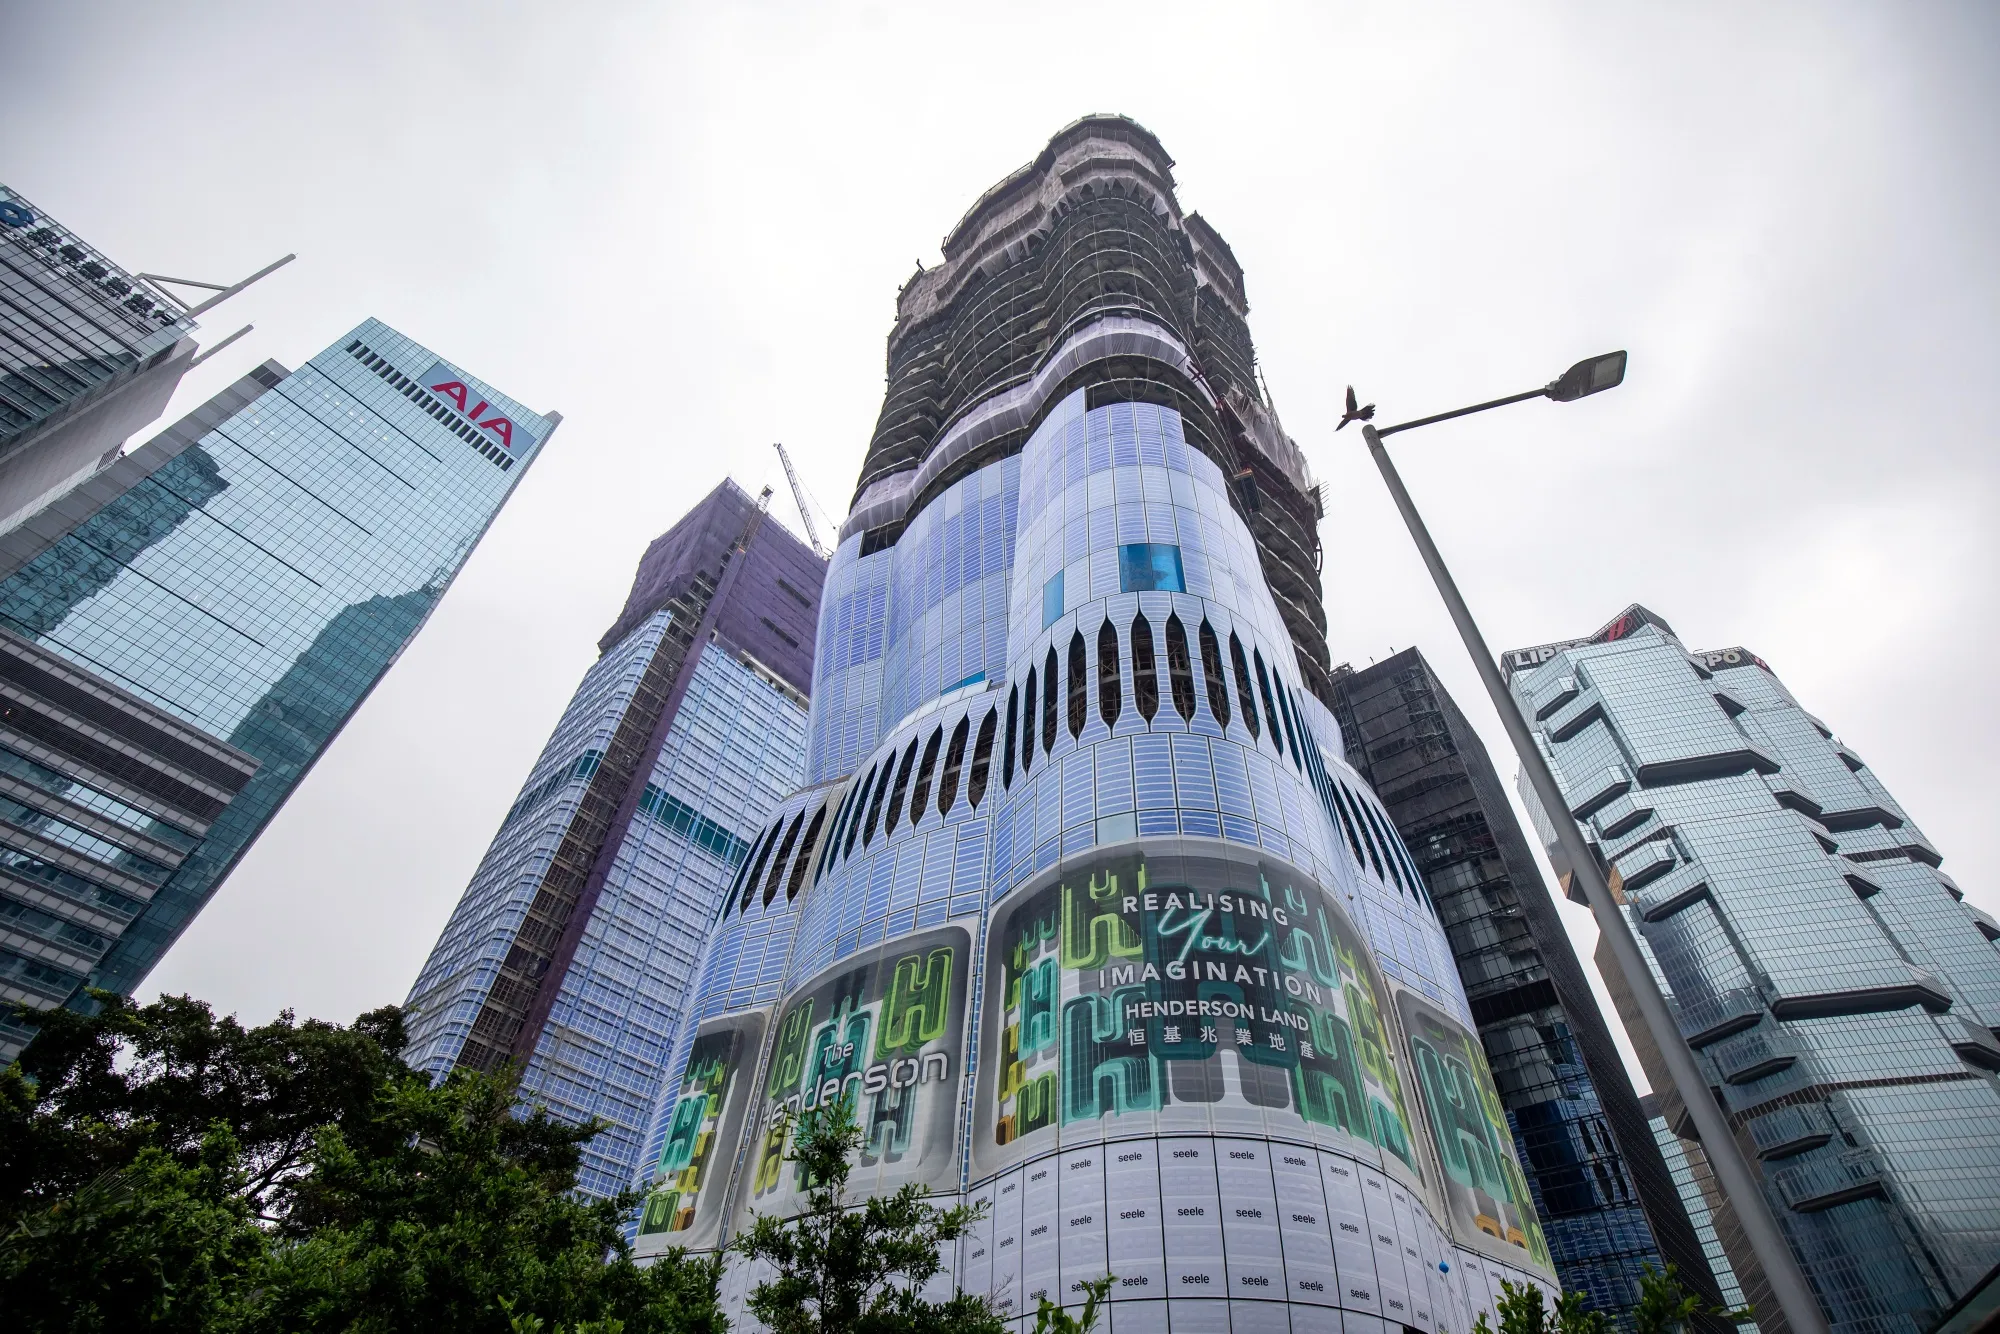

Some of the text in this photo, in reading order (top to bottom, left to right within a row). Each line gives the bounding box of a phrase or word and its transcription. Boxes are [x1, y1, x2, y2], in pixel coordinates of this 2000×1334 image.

[430, 381, 513, 449] AIA
[1122, 892, 1288, 926] REALISING
[1157, 906, 1269, 966] Your
[1099, 960, 1322, 1005] IMAGINATION
[1125, 1000, 1309, 1032] HENDERSON LAND
[1127, 1025, 1315, 1060] 恒基兆業地產
[823, 1041, 854, 1065] The
[755, 1052, 949, 1141] Henderson
[1118, 1151, 1142, 1162] seele
[1173, 1149, 1198, 1159] seele
[1229, 1150, 1255, 1160] seele
[1070, 1159, 1092, 1171] seele
[1283, 1156, 1307, 1167] seele
[1030, 1169, 1047, 1182] seele
[1330, 1165, 1349, 1177] seele
[1120, 1208, 1145, 1220] seele
[1177, 1206, 1204, 1216] seele
[1235, 1208, 1262, 1219] seele
[1070, 1214, 1092, 1227] seele
[1292, 1213, 1316, 1225] seele
[1030, 1224, 1048, 1237] seele
[1339, 1221, 1359, 1234] seele
[1122, 1275, 1148, 1287] seele
[1182, 1273, 1210, 1284] seele
[1241, 1275, 1269, 1287] seele
[1299, 1280, 1324, 1292] seele
[1350, 1288, 1370, 1301] seele
